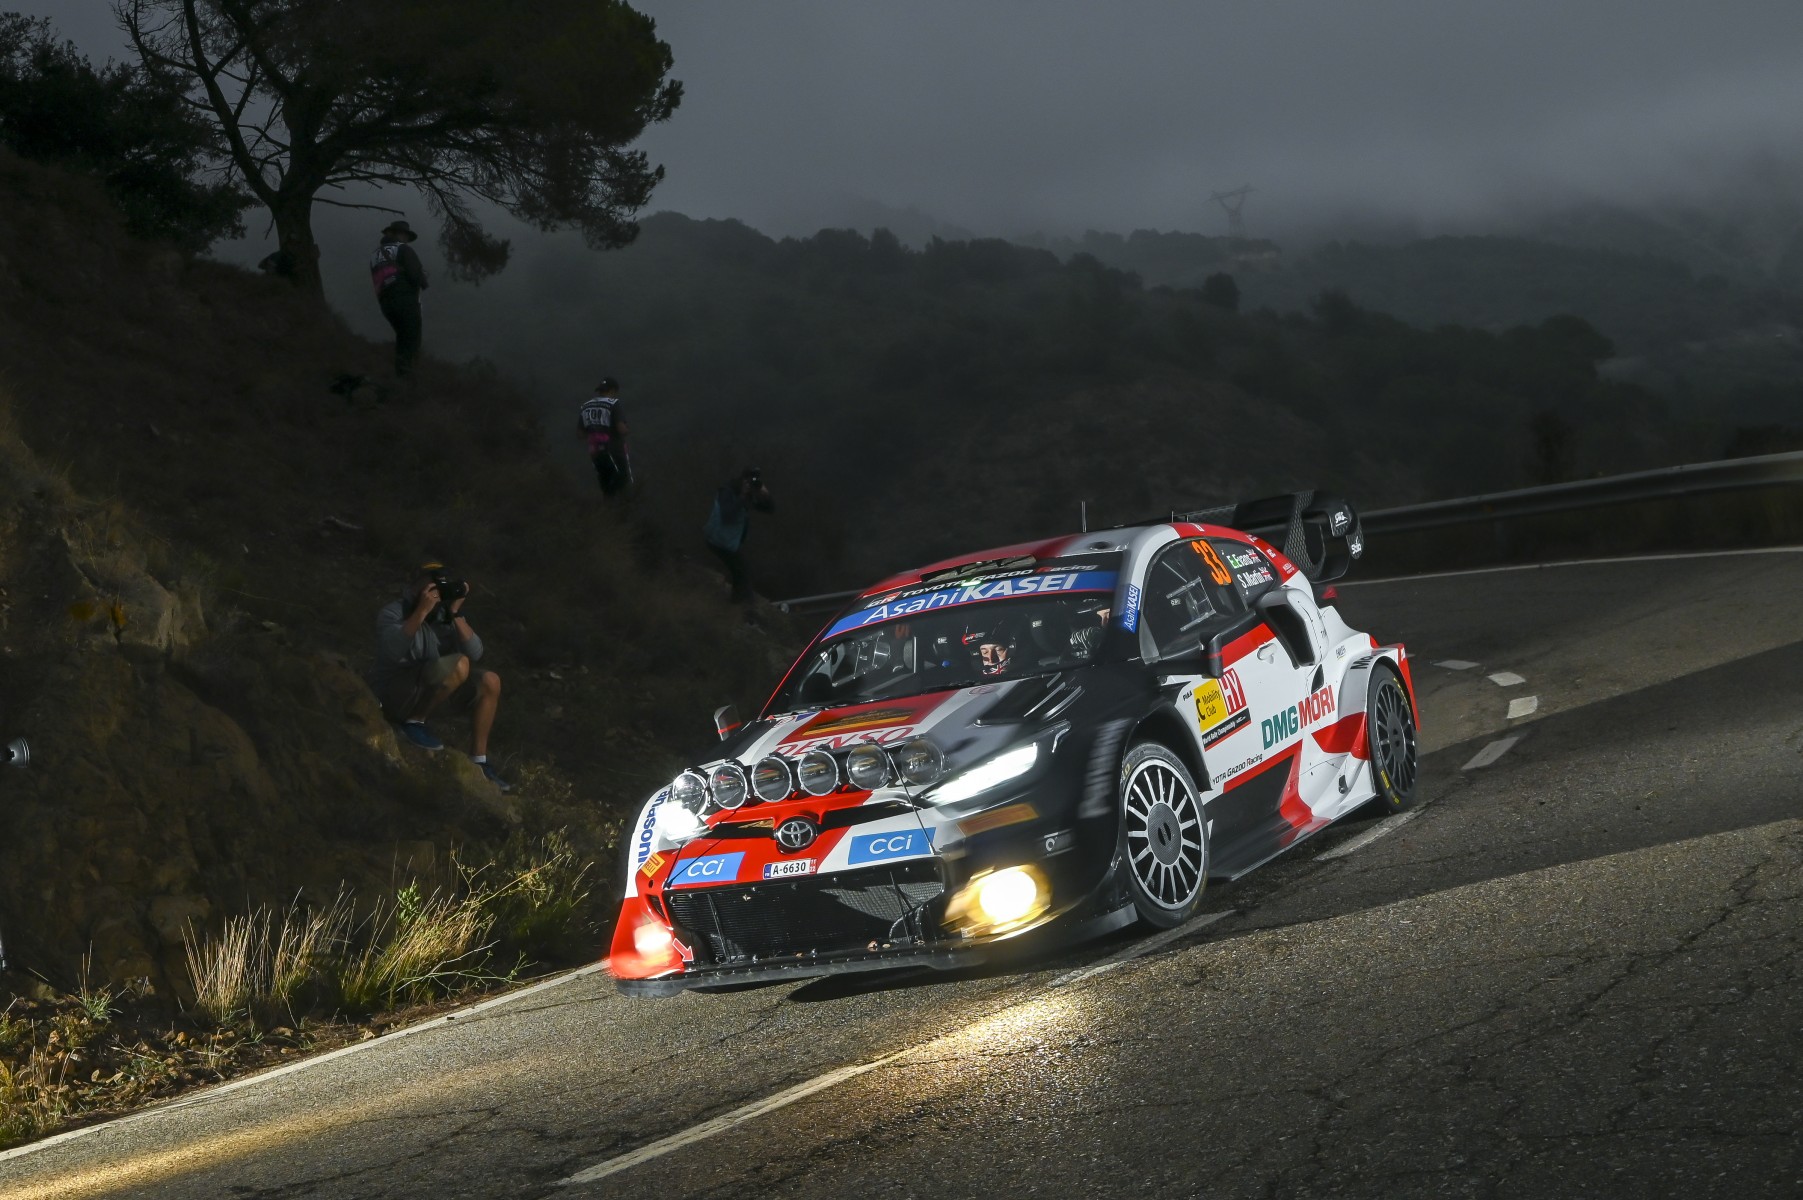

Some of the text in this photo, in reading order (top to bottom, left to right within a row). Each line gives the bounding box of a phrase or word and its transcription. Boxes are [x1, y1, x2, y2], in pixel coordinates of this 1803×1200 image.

[1188, 540, 1232, 585] 33
[863, 574, 1079, 624] AsahiKASEI
[1201, 690, 1221, 705] Mobility
[1206, 704, 1217, 717] Club
[1261, 685, 1335, 750] DMG MORI
[774, 726, 914, 755] DENSO
[1247, 753, 1263, 767] Racing
[773, 862, 806, 876] A-6630
